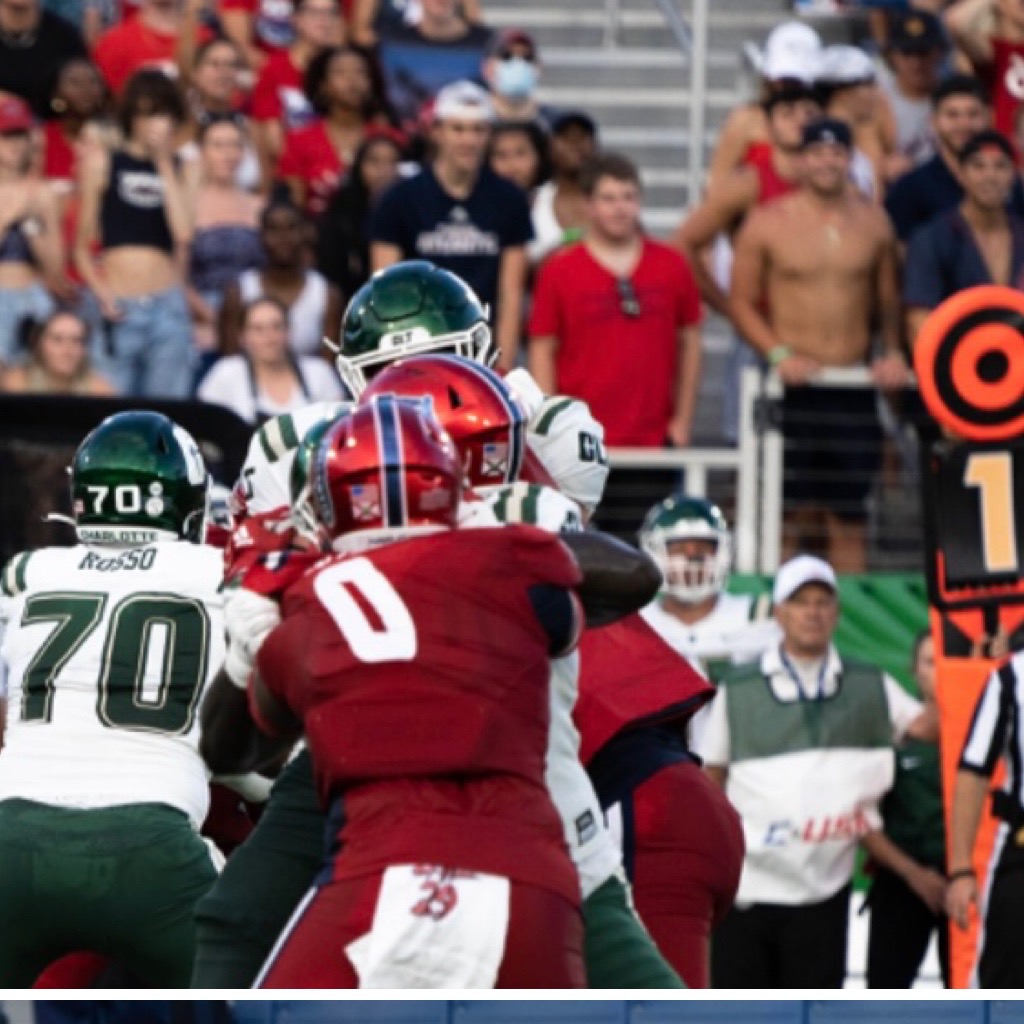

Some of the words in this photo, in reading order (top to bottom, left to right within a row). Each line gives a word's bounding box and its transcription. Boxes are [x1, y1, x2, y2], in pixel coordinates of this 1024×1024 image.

[87, 485, 142, 515] 70
[964, 453, 1018, 572] 1
[21, 590, 212, 735] 70
[314, 557, 417, 662] 0
